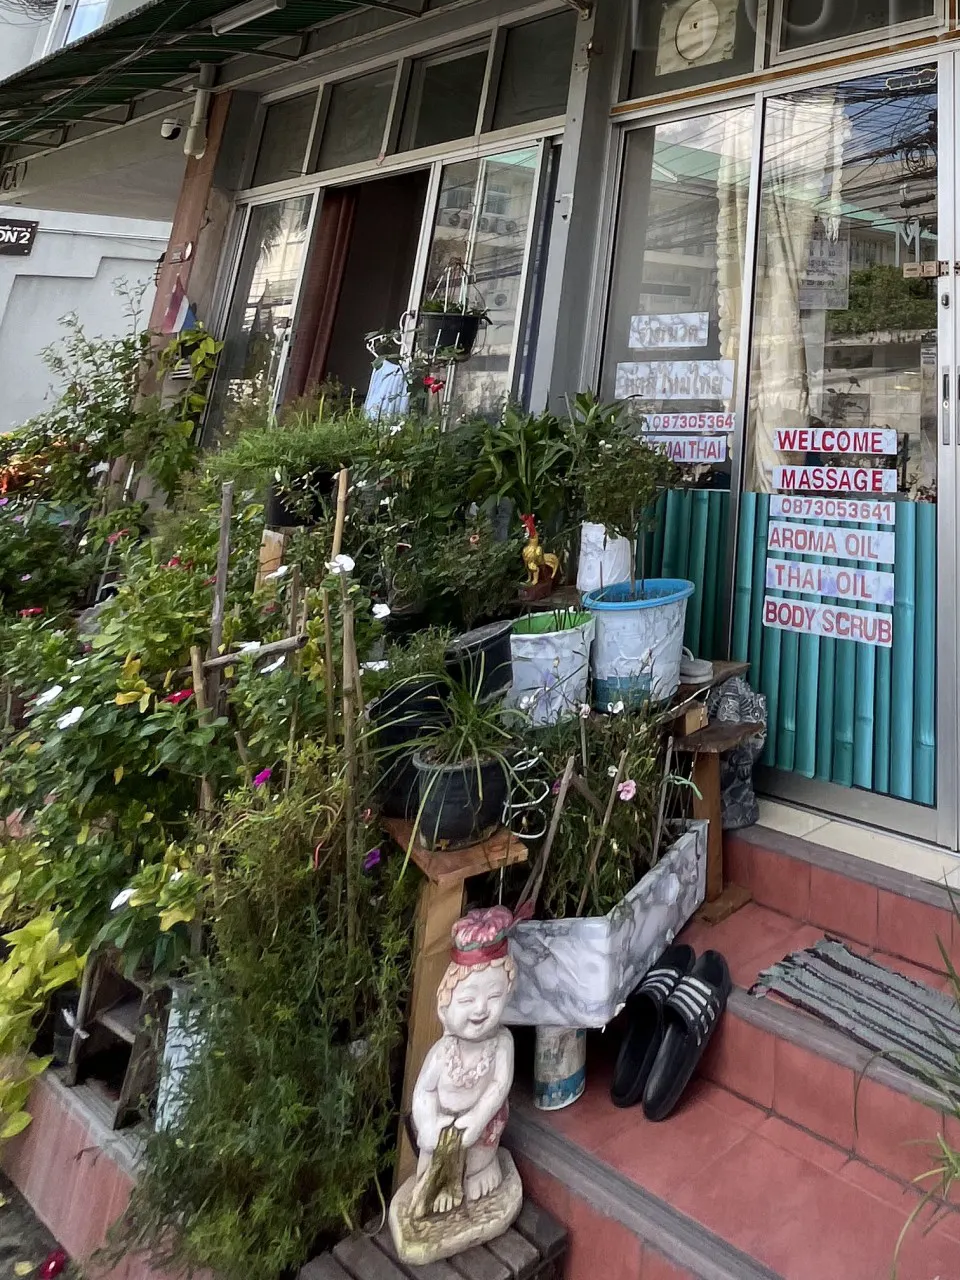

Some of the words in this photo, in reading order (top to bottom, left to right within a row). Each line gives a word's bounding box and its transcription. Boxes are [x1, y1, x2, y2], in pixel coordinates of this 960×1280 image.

[777, 430, 883, 453] WELCOME
[781, 468, 883, 492] MASSAGE
[782, 497, 890, 521] 0873053641
[769, 527, 837, 554] AROMA
[845, 533, 878, 560] OIL
[775, 564, 822, 592] THAI
[836, 571, 872, 599] OIL
[765, 600, 817, 631] BODY
[822, 608, 892, 643] SCRUB
